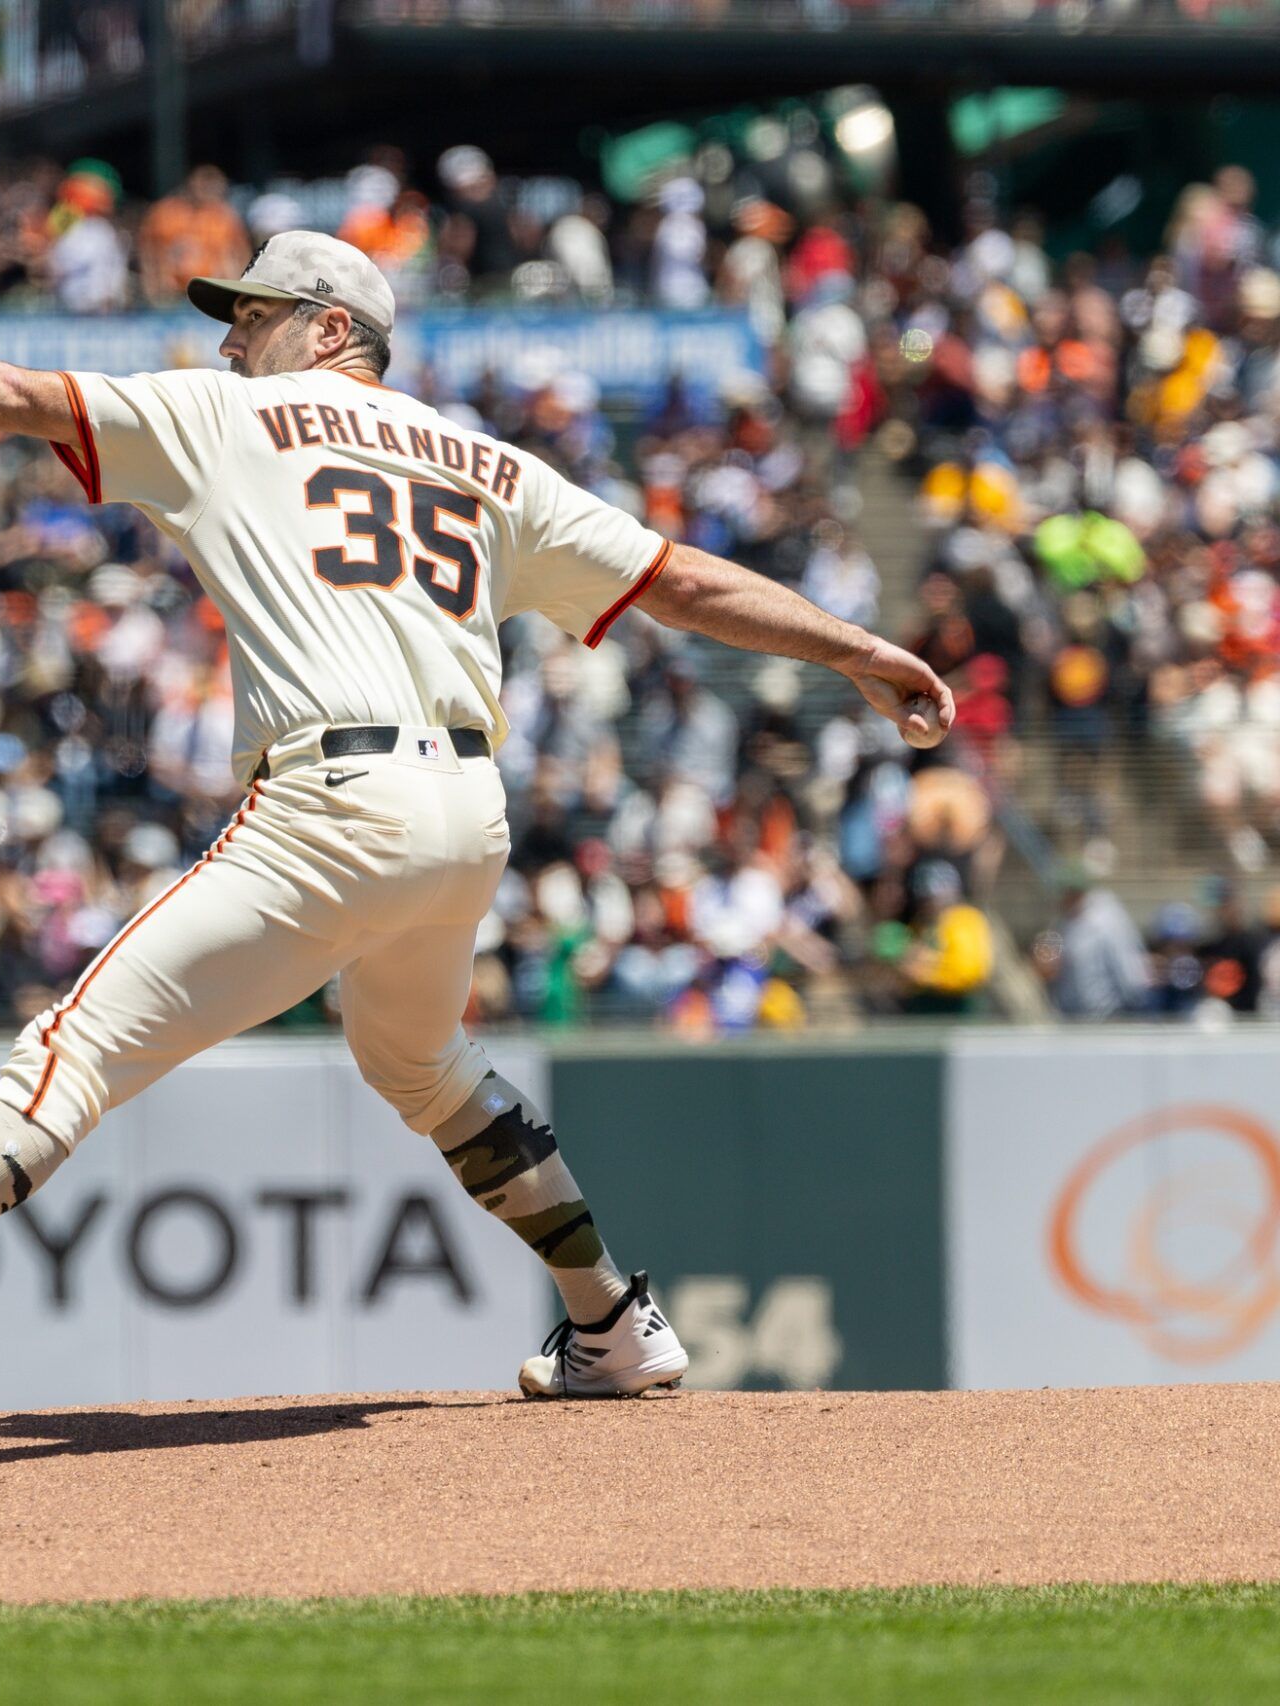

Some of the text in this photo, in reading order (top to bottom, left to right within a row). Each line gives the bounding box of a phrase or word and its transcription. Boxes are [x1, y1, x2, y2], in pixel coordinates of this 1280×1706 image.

[257, 402, 522, 506] VERLANDER
[304, 465, 482, 623] 35
[650, 1275, 842, 1390] 54
